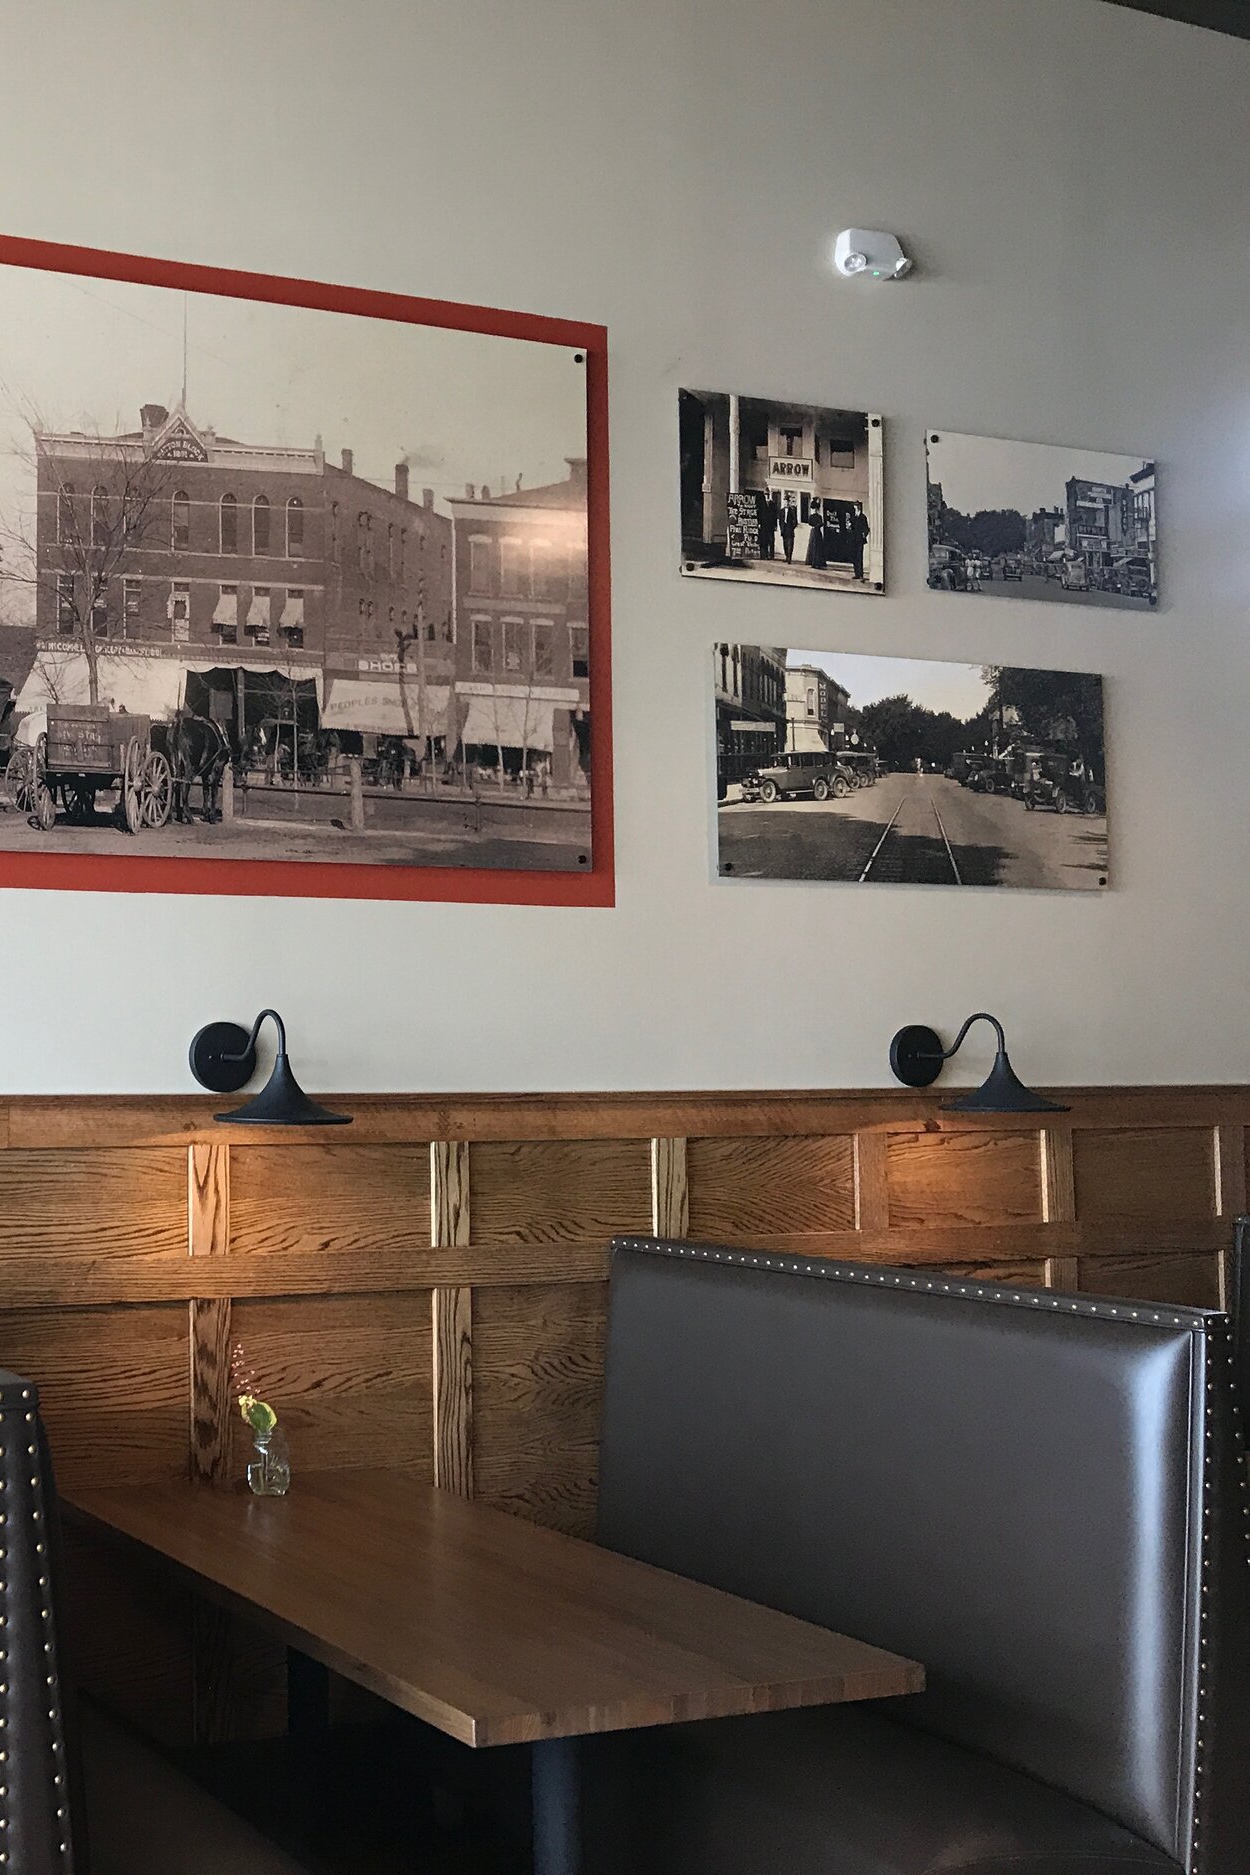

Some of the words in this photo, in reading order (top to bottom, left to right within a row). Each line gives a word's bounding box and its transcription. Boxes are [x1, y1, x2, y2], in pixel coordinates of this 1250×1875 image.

[772, 461, 810, 477] ARROW
[727, 494, 756, 506] ARROW
[819, 683, 828, 718] MODEL
